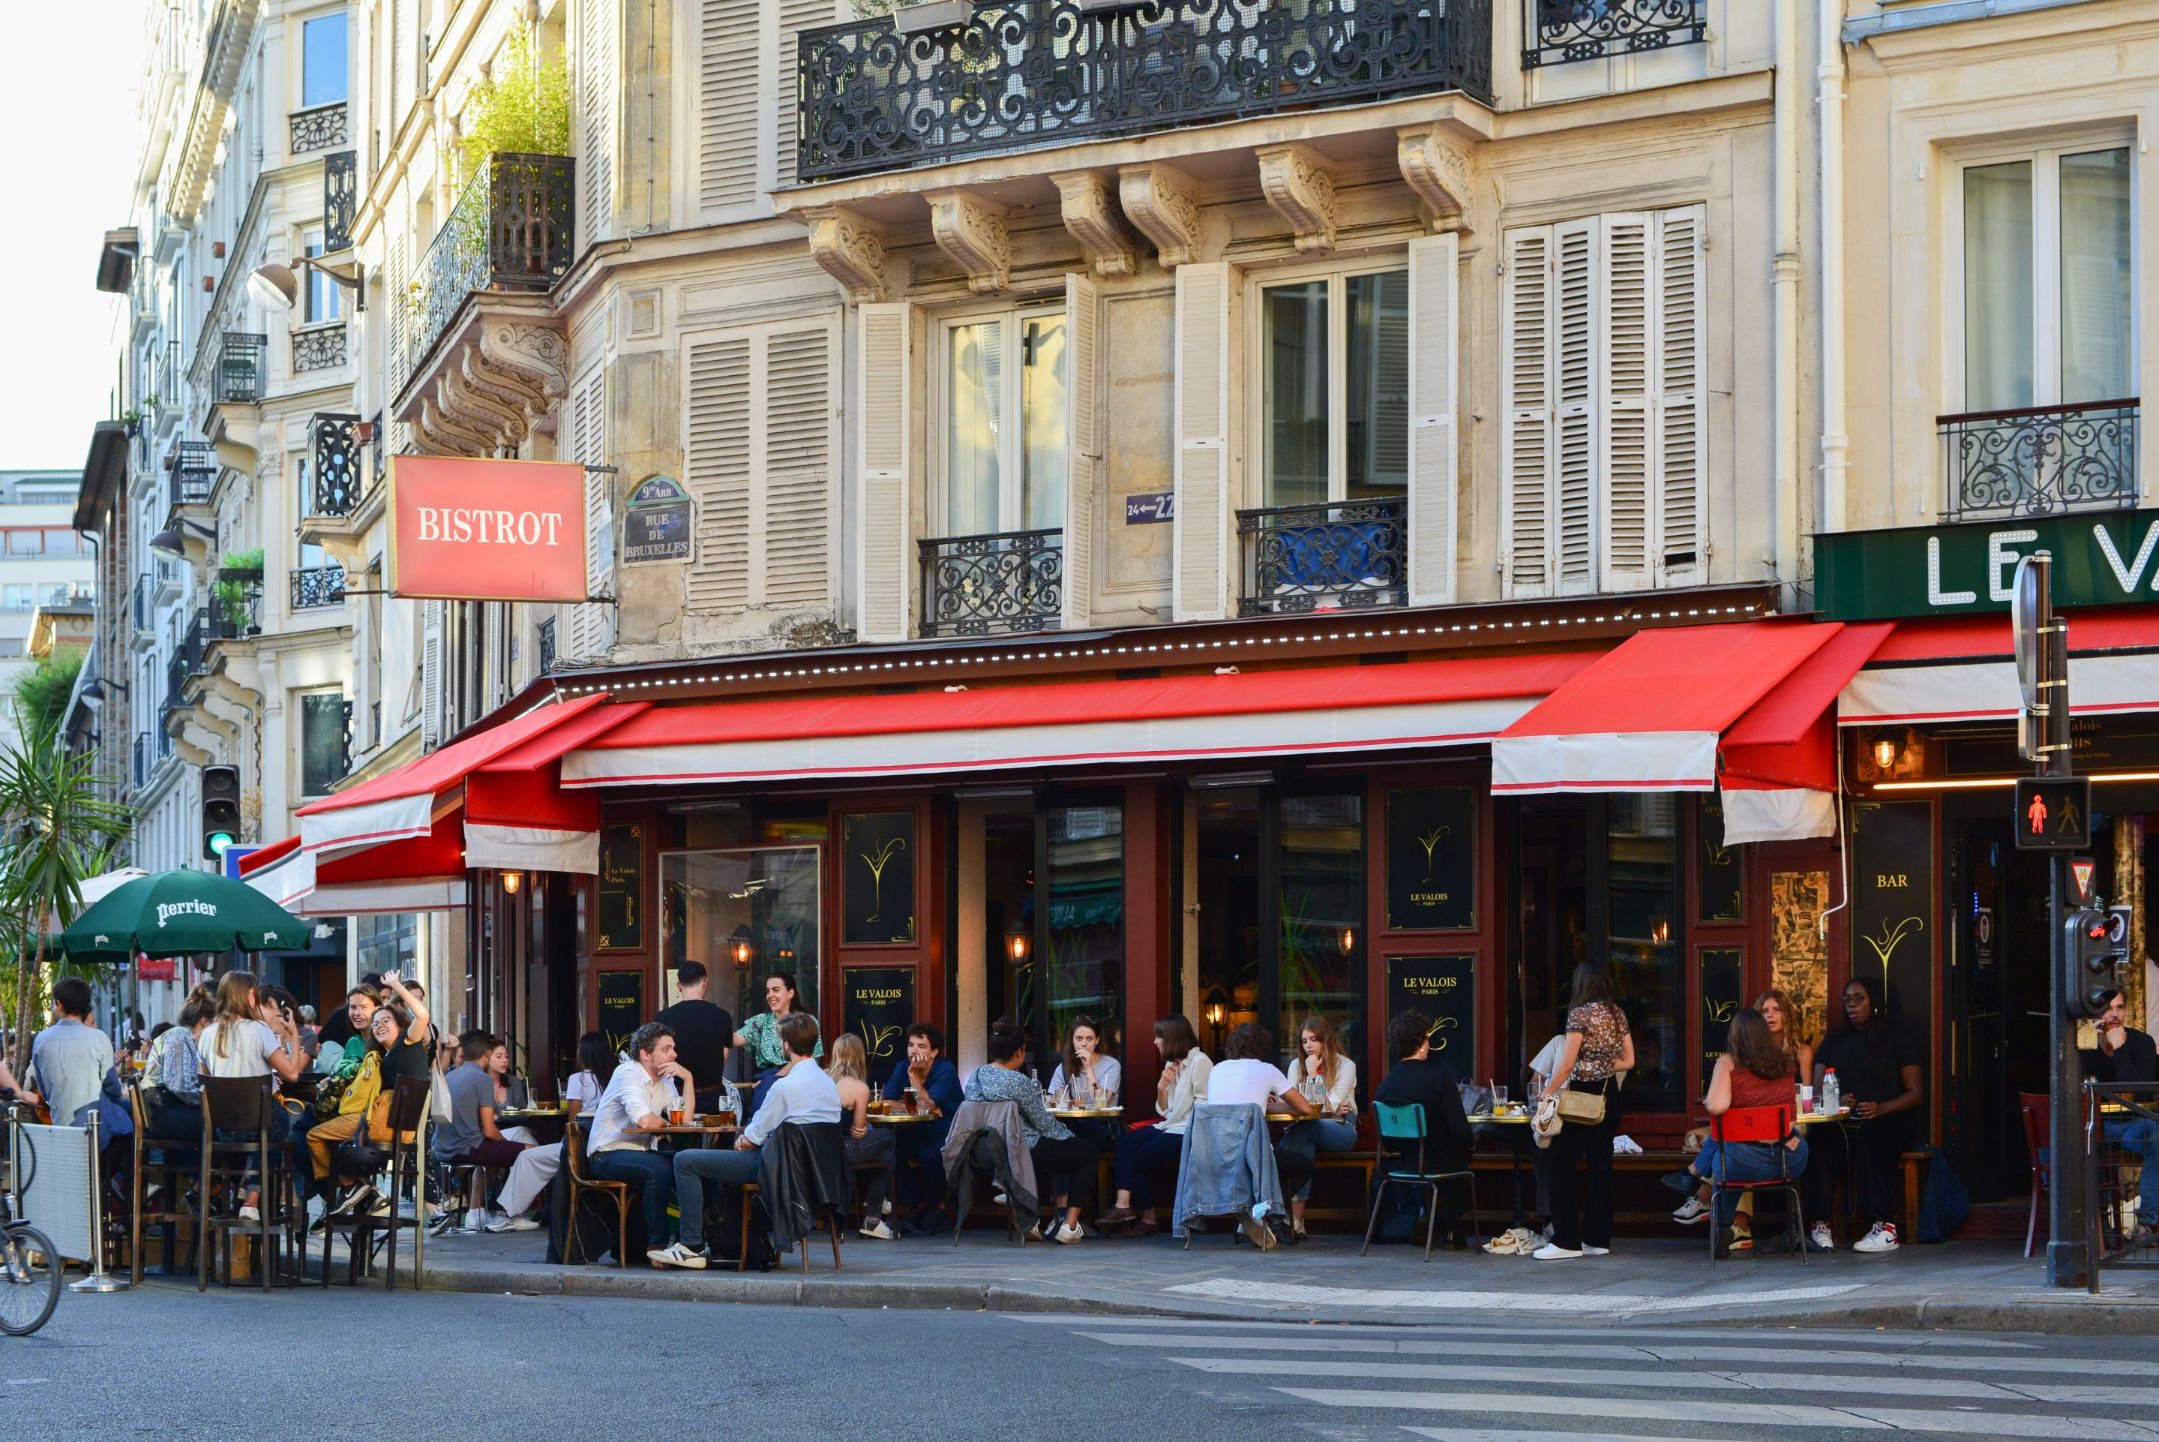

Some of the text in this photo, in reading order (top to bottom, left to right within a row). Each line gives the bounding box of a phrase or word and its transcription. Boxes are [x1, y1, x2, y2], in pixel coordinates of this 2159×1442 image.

[1127, 494, 1174, 519] 24 22
[645, 513, 670, 526] RUE
[416, 507, 563, 546] BISTROT
[648, 529, 665, 541] DE
[624, 541, 689, 558] BRUXELLES
[1927, 519, 2159, 606] LE V
[1877, 874, 1908, 888] BAR
[1410, 892, 1449, 902] LE VALOIS
[1403, 976, 1457, 988] LE VALOIS
[856, 988, 902, 999] LE VALOIS
[1421, 988, 1439, 996] PARIS
[604, 997, 613, 1005] LE
